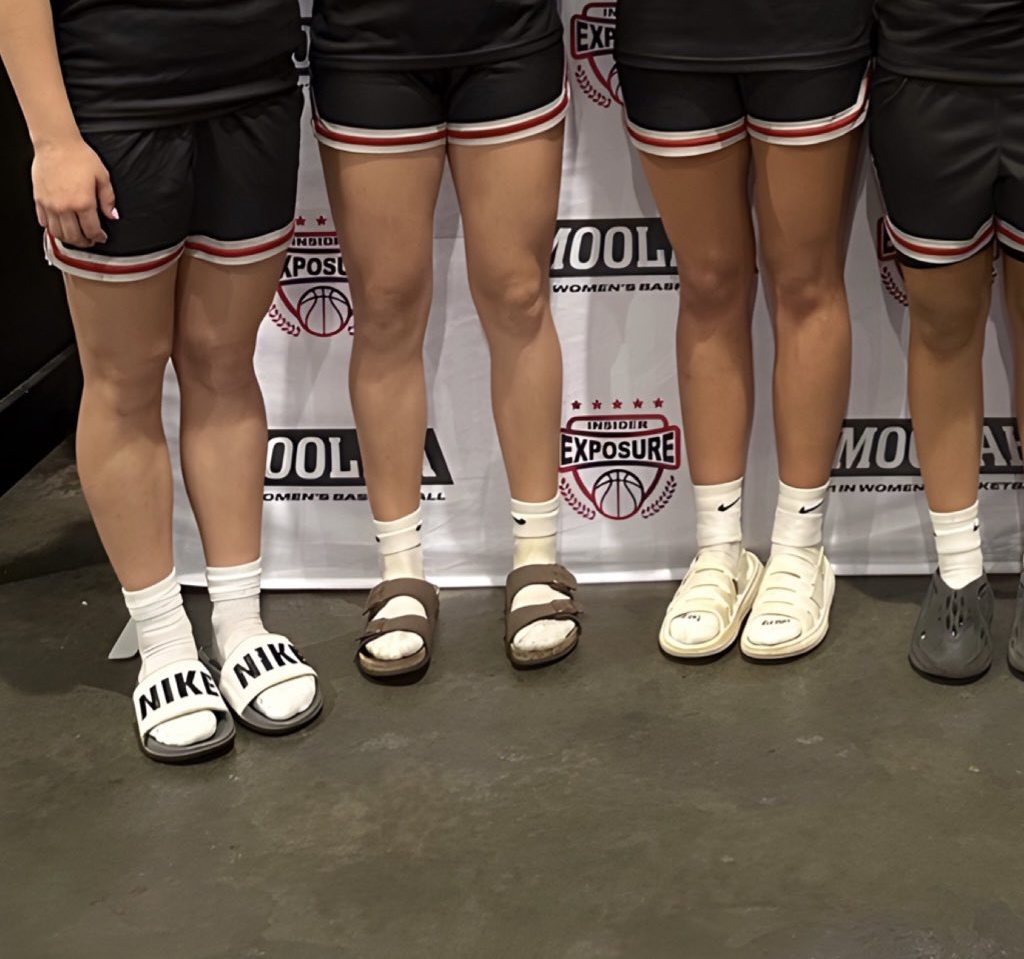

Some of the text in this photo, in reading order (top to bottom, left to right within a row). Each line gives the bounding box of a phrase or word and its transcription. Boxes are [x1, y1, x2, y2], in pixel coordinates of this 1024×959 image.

[587, 420, 648, 430] INSIDER
[561, 432, 675, 466] EXPOSURE
[263, 493, 329, 501] OMEN'S
[139, 669, 220, 721] NIKE
